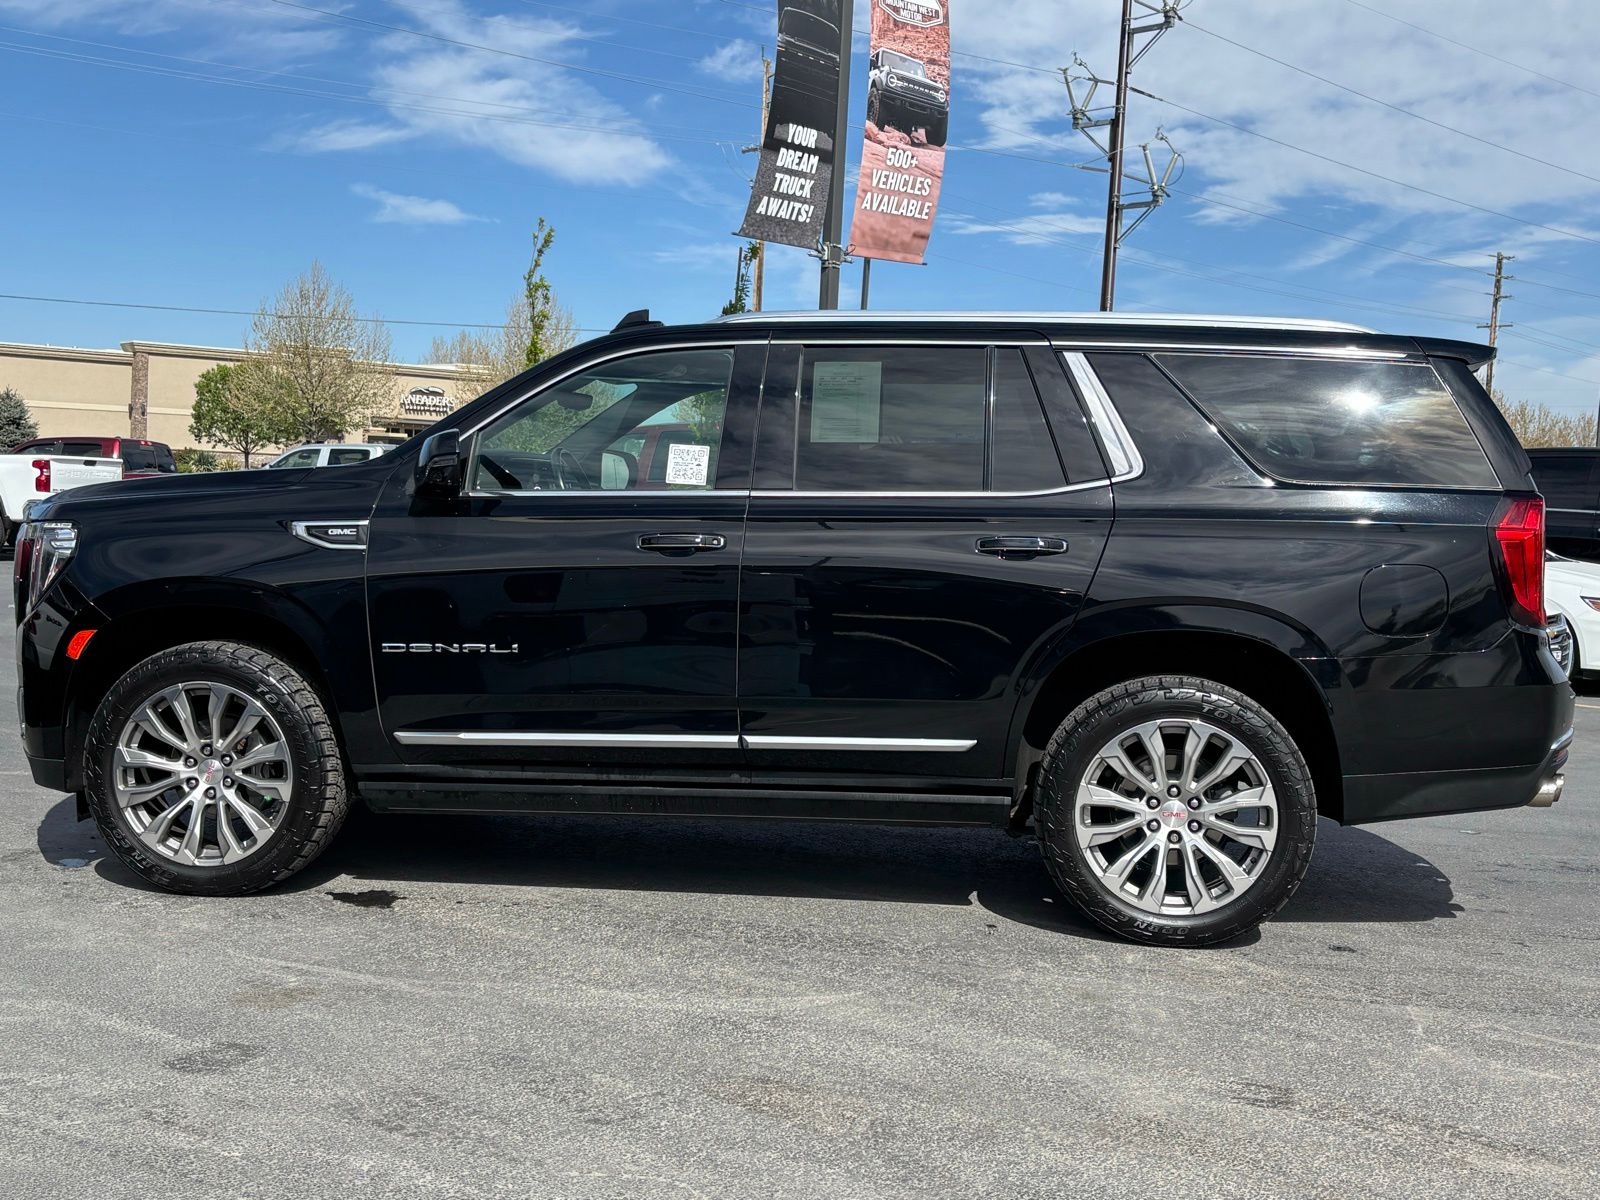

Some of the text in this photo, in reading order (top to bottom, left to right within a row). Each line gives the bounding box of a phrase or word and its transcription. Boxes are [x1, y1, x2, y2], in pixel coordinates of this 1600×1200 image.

[900, 9, 923, 22] MOTOR
[918, 5, 936, 17] WEST
[787, 123, 818, 149] YOUR
[776, 147, 820, 174] DREAM
[886, 147, 919, 169] 500+
[772, 173, 815, 198] TRUCK
[872, 168, 932, 196] VEHICLES
[756, 195, 815, 223] AWAITS!
[861, 191, 933, 220] AVAILABLE
[381, 643, 519, 653] DENALI
[1202, 704, 1259, 735] TOYO
[1162, 811, 1187, 819] GMC
